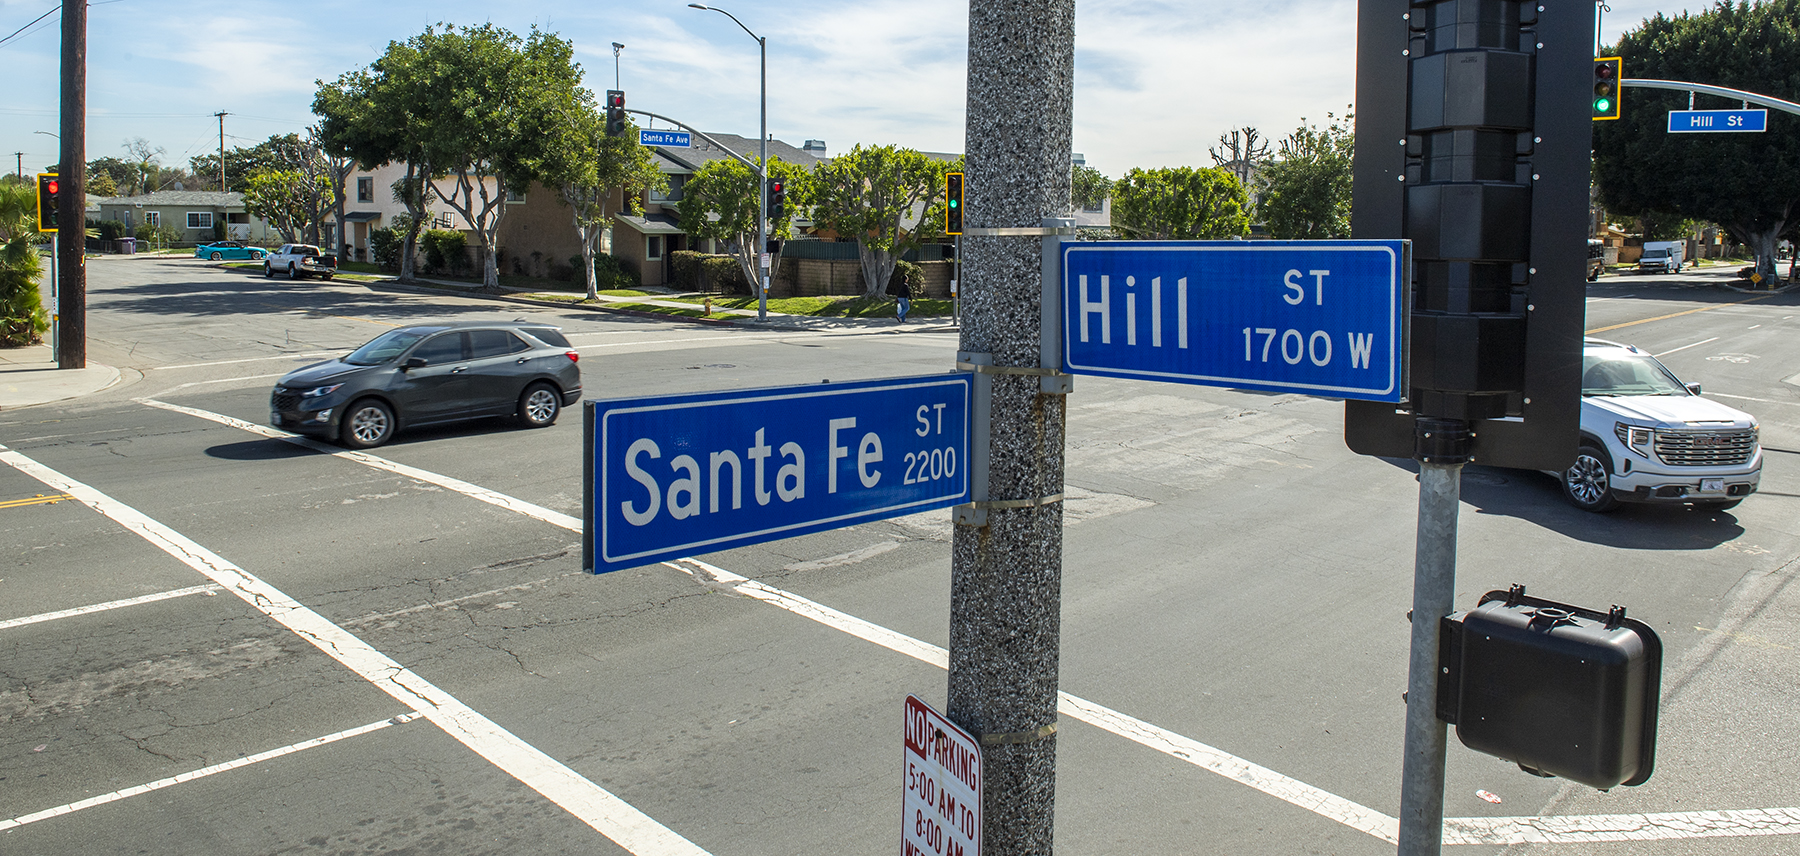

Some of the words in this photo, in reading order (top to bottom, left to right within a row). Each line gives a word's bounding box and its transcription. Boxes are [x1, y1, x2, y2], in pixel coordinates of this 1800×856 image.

[643, 133, 663, 143] Santa
[665, 134, 674, 143] Fe
[675, 135, 688, 144] Ave
[1690, 115, 1713, 127] Hill
[1727, 115, 1744, 127] St
[1079, 274, 1188, 349] Hill
[1282, 269, 1330, 306] ST
[1242, 327, 1332, 367] 1700
[1348, 332, 1373, 369] W
[621, 426, 805, 526] Santa
[828, 416, 883, 494] Fe
[915, 403, 946, 437] ST
[903, 446, 956, 486] 2200
[906, 702, 926, 750] NO
[928, 721, 977, 792] PARKING
[909, 762, 934, 807] 5:00
[938, 788, 955, 826] AM
[960, 803, 974, 841] TO
[916, 808, 942, 854] 8:00
